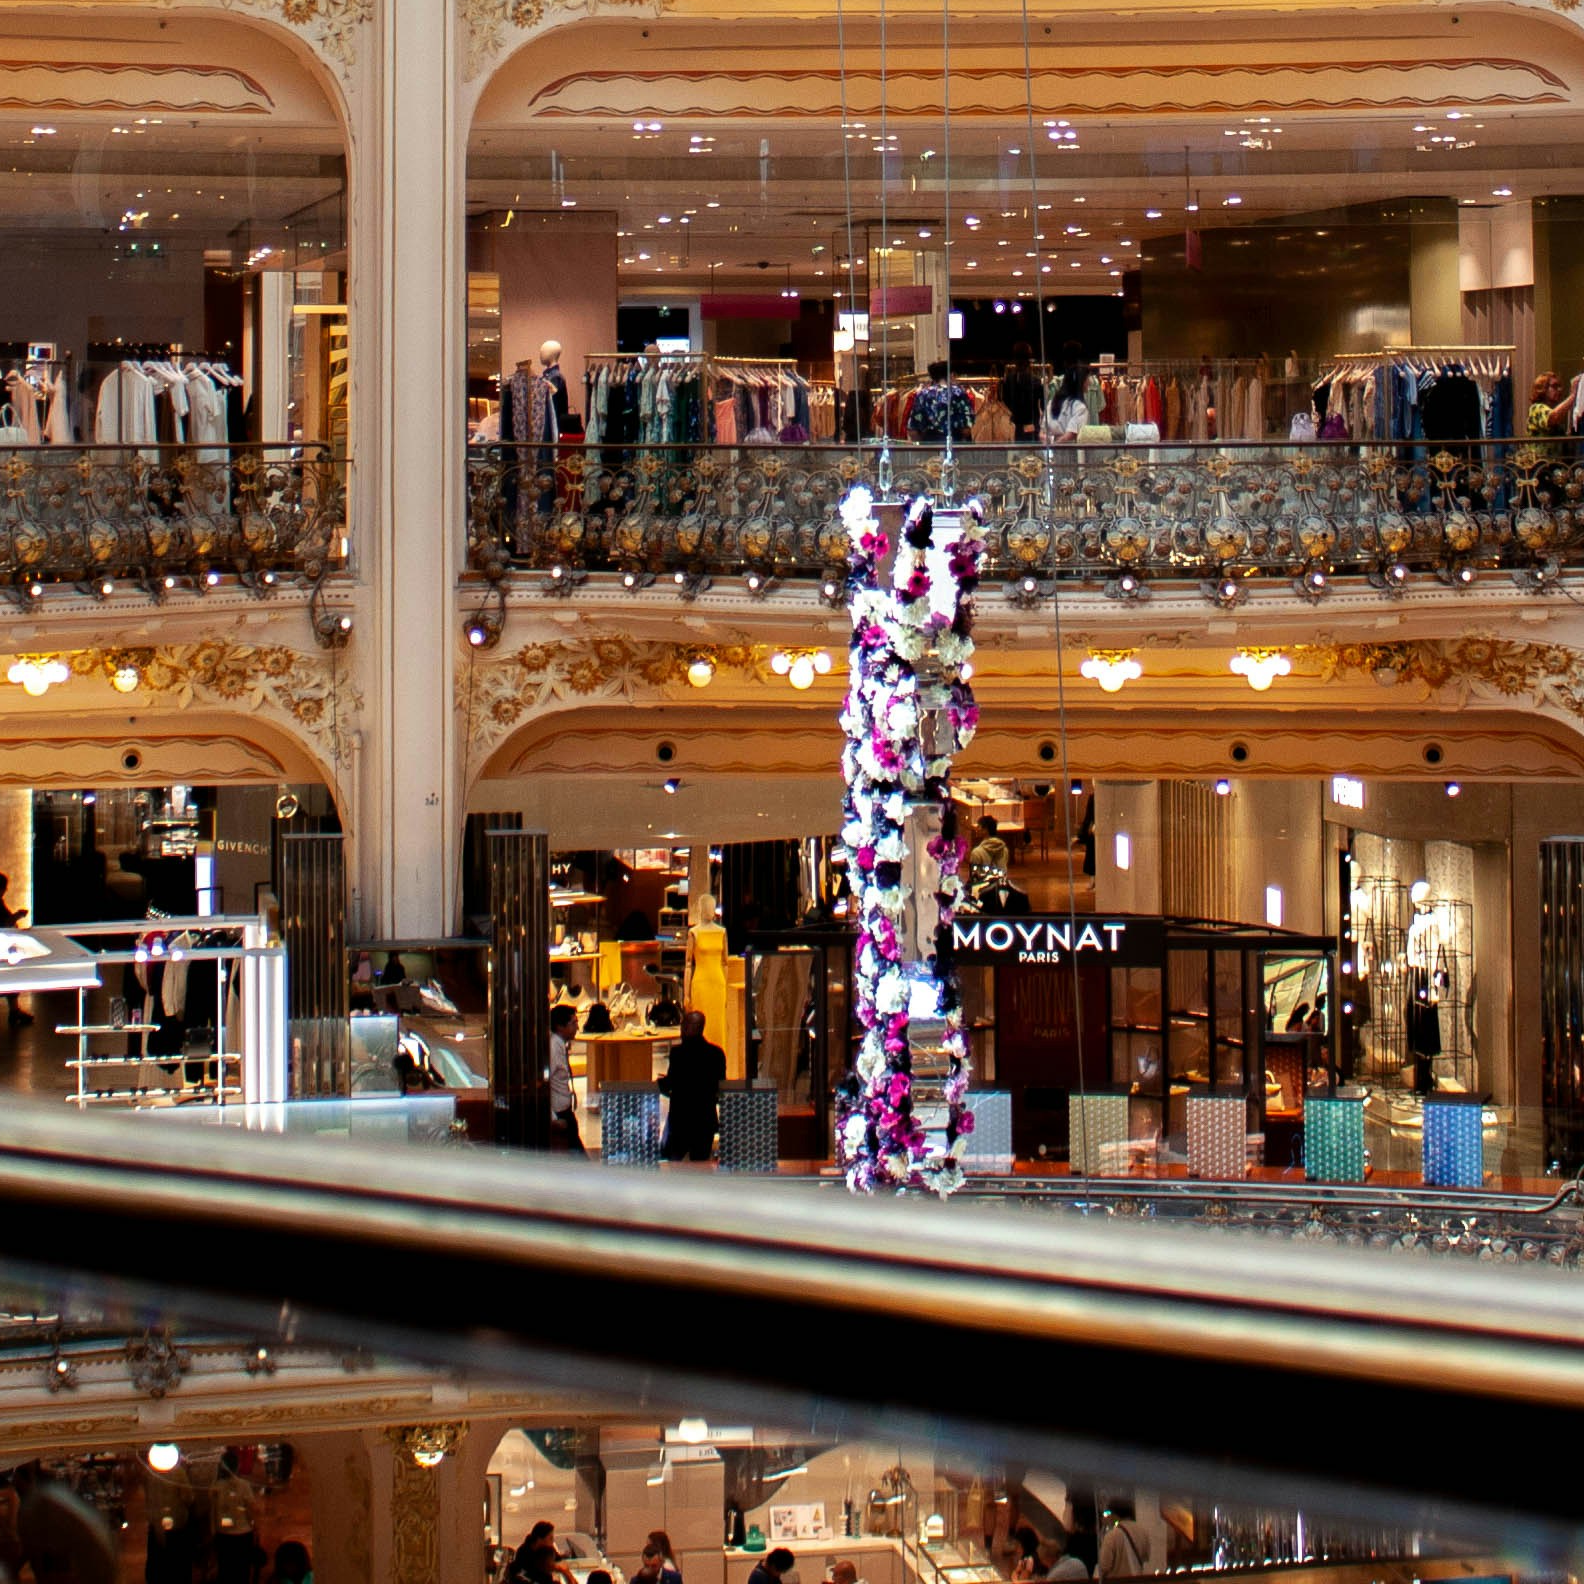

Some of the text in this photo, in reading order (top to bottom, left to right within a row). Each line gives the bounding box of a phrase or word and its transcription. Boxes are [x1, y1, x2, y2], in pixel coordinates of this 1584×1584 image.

[217, 840, 271, 856] GIVENCH
[952, 922, 1126, 952] MOYNAT
[1018, 951, 1060, 964] PARIS
